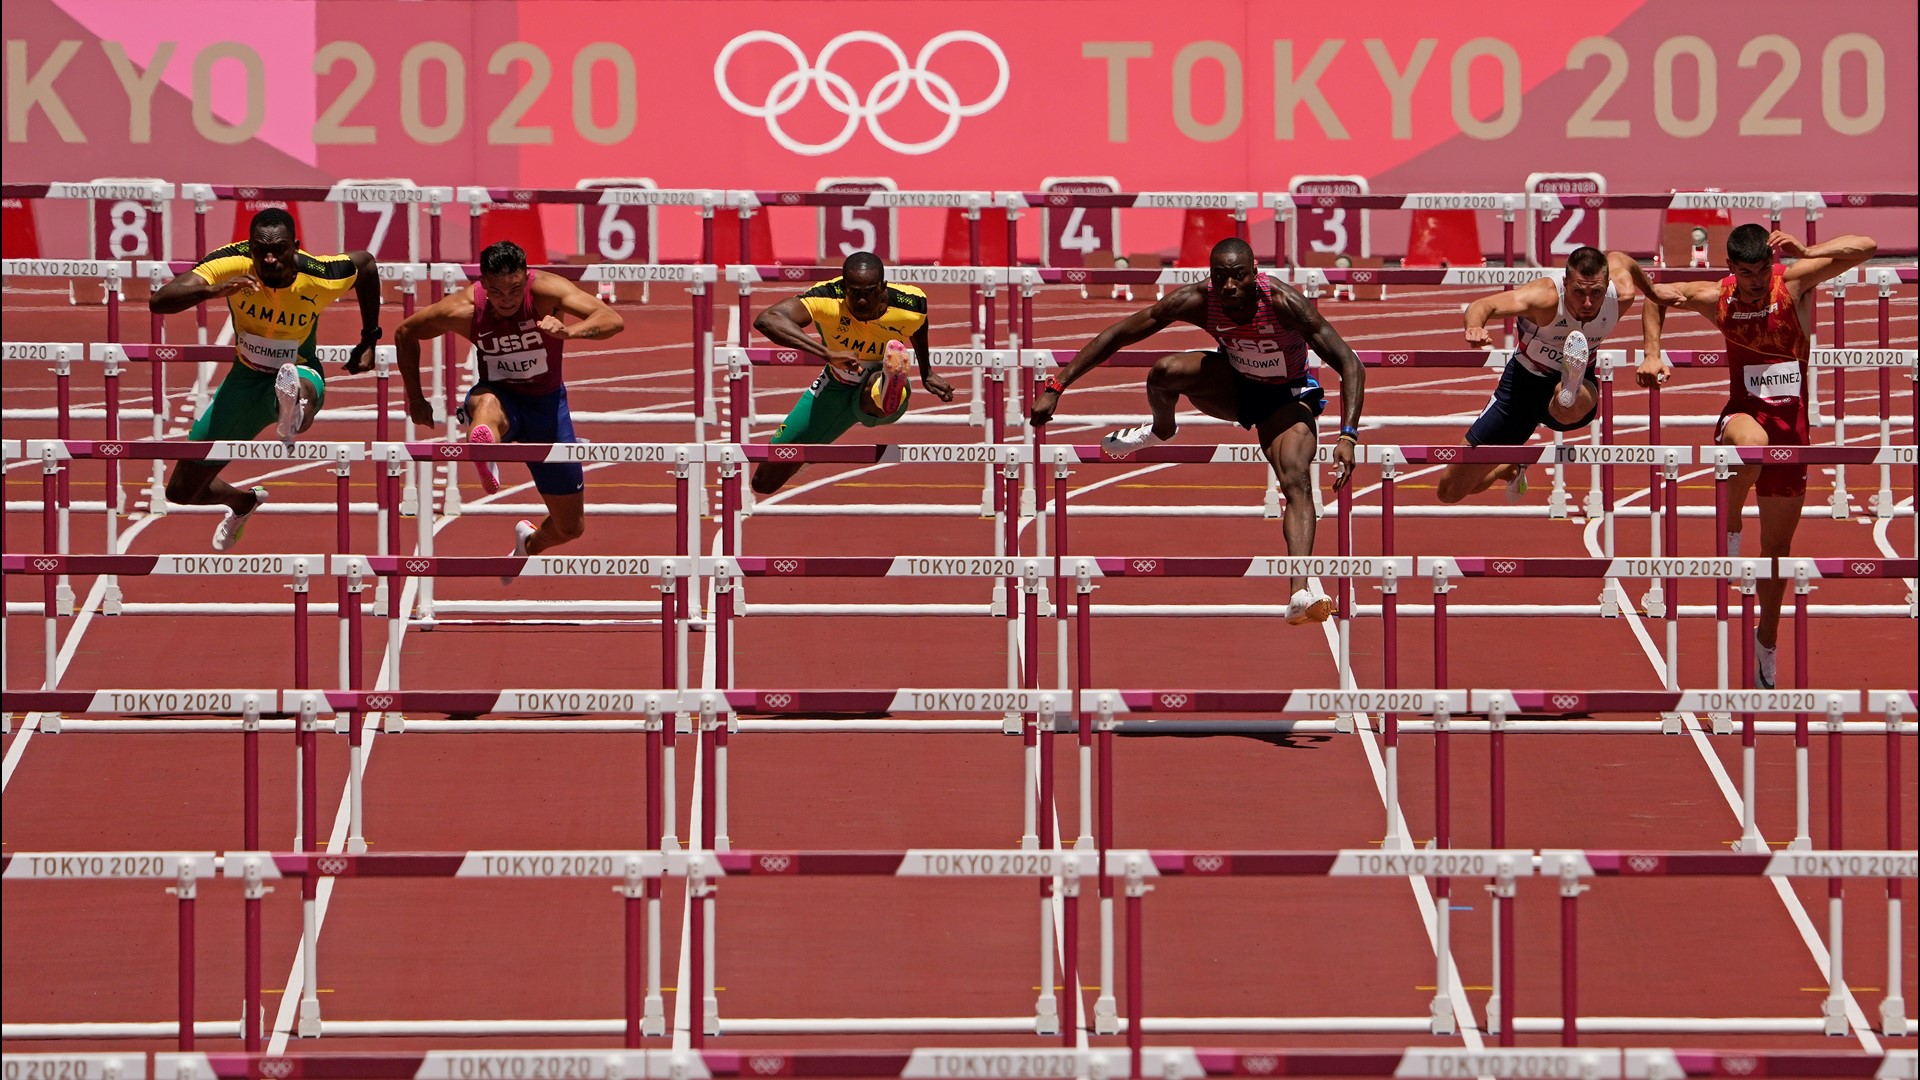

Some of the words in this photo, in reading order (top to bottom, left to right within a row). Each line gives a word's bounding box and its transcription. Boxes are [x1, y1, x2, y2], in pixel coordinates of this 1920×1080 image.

[6, 40, 265, 145] KYO
[311, 41, 637, 145] 2020
[1082, 36, 1522, 143] TOKYO
[1565, 32, 1886, 138] 2020
[62, 186, 107, 198] TOKYO
[111, 186, 145, 199] 2020
[342, 189, 385, 201] TOKYO
[389, 190, 423, 201] 2020
[614, 192, 660, 204] TOKYO
[663, 192, 695, 205] 2020
[881, 194, 926, 206] TOKYO
[929, 194, 961, 206] 2020
[1149, 195, 1193, 207] TOKYO
[1195, 195, 1228, 207] 2020
[1416, 196, 1461, 209] TOKYO
[1463, 196, 1496, 208] 2020
[1684, 196, 1729, 208] TOKYO
[1732, 196, 1765, 208] 2020
[109, 200, 148, 260] 8
[357, 201, 395, 258] 7
[598, 203, 636, 260] 6
[839, 206, 877, 258] 5
[1060, 207, 1100, 254] 4
[1310, 207, 1348, 254] 3
[1550, 207, 1585, 254] 2
[9, 262, 59, 275] TOKYO
[62, 262, 98, 275] 2020
[600, 267, 646, 279] TOKYO
[650, 267, 685, 280] 2020
[891, 269, 937, 282] TOKYO
[942, 269, 976, 282] 2020
[1173, 271, 1210, 283] TOKY
[1458, 270, 1505, 284] TOKYO
[239, 338, 296, 359] PARCHMENT
[477, 331, 543, 354] USA
[832, 334, 885, 356] JAMAI
[1219, 336, 1279, 354] USA
[9, 346, 47, 359] 2020
[945, 352, 983, 365] 2020
[1230, 352, 1280, 368] HOLLOWAY
[1539, 346, 1564, 364] POZ
[1812, 352, 1861, 364] TOKYO
[1866, 352, 1903, 364] 2020
[497, 358, 537, 372] ALLEN
[1750, 372, 1800, 386] MARTINEZ
[227, 444, 284, 459] TOKYO
[286, 444, 328, 459] 2020
[565, 445, 620, 460] TOKYO
[624, 446, 665, 461] 2020
[899, 447, 952, 461] TOKYO
[956, 447, 997, 462] 2020
[1229, 447, 1263, 461] TOK
[1556, 448, 1611, 462] TOKYO
[1615, 448, 1655, 463] 2020
[172, 557, 234, 574] TOKYO
[238, 557, 283, 574] 2020
[541, 558, 601, 574] TOKYO
[605, 558, 649, 574] 2020
[907, 558, 966, 575] TOKYO
[971, 558, 1015, 575] 2020
[1266, 559, 1324, 575] TOKYO
[1329, 559, 1373, 575] 2020
[1626, 560, 1685, 576] TOKYO
[1688, 560, 1733, 576] 2020
[110, 693, 177, 712] TOKYO
[182, 693, 232, 712] 2020
[515, 693, 580, 711] TOKYO
[583, 693, 634, 711] 2020
[911, 693, 976, 711] TOKYO
[981, 693, 1029, 711] 2020
[1306, 693, 1371, 711] TOKYO
[1374, 693, 1423, 711] 2020
[1698, 693, 1763, 711] TOKYO
[1766, 693, 1815, 711] 2020
[29, 856, 105, 876] TOKYO
[109, 856, 165, 876] 2020
[482, 856, 555, 876] TOKYO
[558, 856, 613, 876] 2020
[923, 854, 995, 874] TOKYO
[1000, 854, 1052, 874] 2020
[1355, 855, 1427, 875] TOKYO
[1430, 855, 1484, 875] 2020
[1791, 856, 1862, 875] TOKYO
[1868, 856, 1918, 875] 2020
[27, 1060, 87, 1080] 2020
[445, 1057, 525, 1079] TOKYO
[531, 1057, 590, 1079] 2020
[932, 1055, 1013, 1077] TOKYO
[1018, 1055, 1075, 1077] 2020
[1425, 1055, 1504, 1077] TOKYO
[1511, 1055, 1568, 1077] 2020
